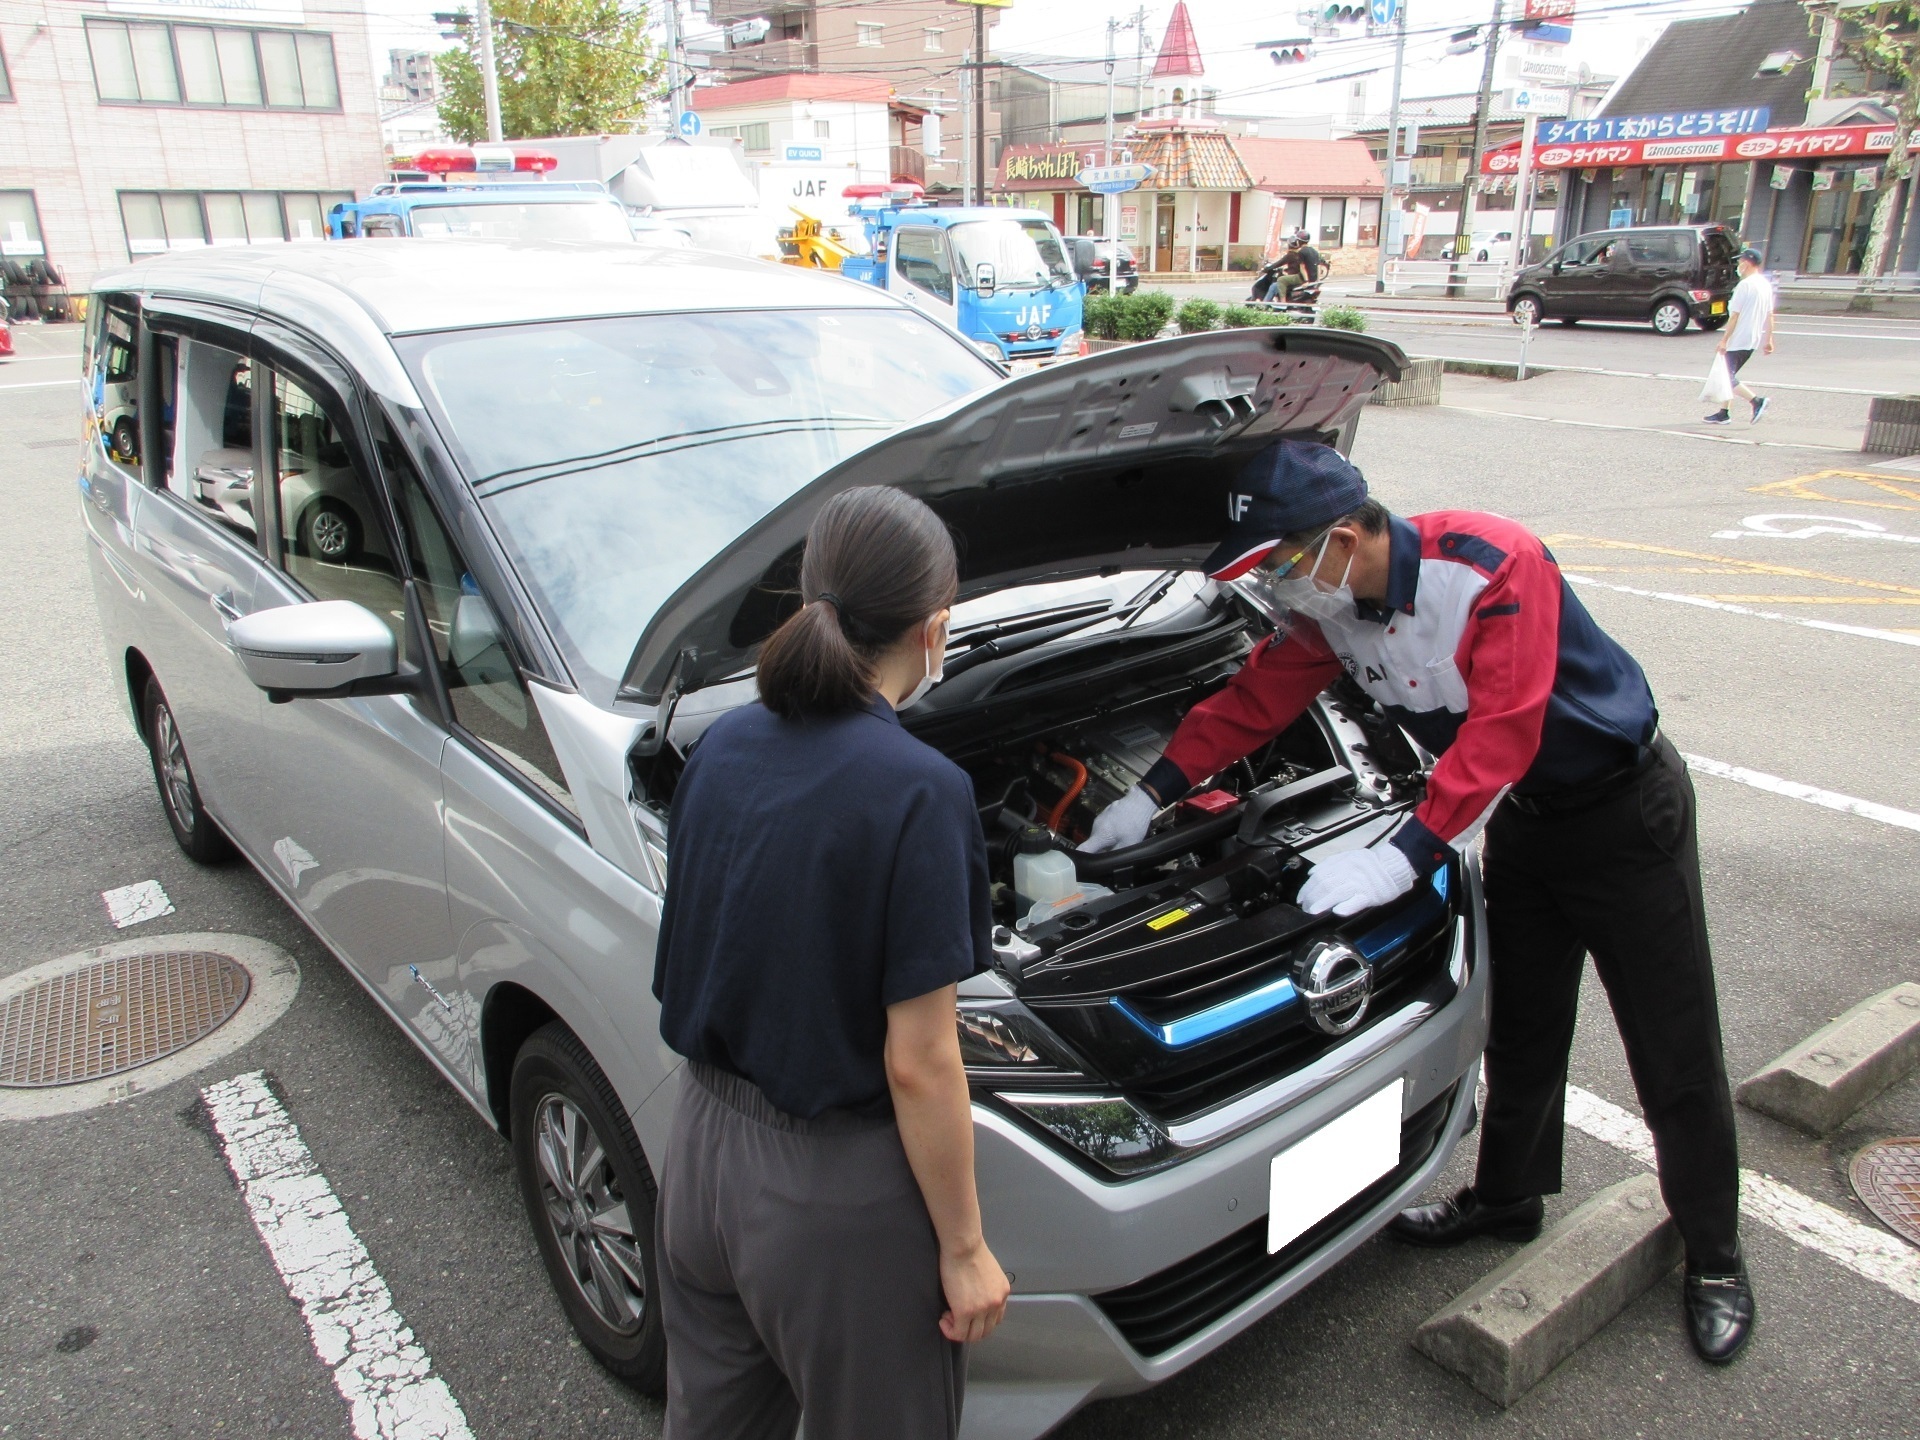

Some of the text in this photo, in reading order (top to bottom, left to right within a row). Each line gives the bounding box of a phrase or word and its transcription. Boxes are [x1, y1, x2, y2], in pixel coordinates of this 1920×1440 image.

[1523, 61, 1567, 76] BRIDGESTONE
[1543, 94, 1562, 105] Safety
[1647, 144, 1720, 156] BRIDGESTONE
[1743, 134, 1853, 154] ミスター タイヤマン
[788, 149, 820, 158] EV QUICK
[1543, 146, 1632, 164] ミスター タイヤマン
[1005, 151, 1080, 181] 長崎ちゃんぽん
[793, 180, 827, 197] JAF
[860, 271, 873, 281] JAF
[1015, 304, 1052, 326] JAF
[1322, 979, 1373, 1012] NISSAN
